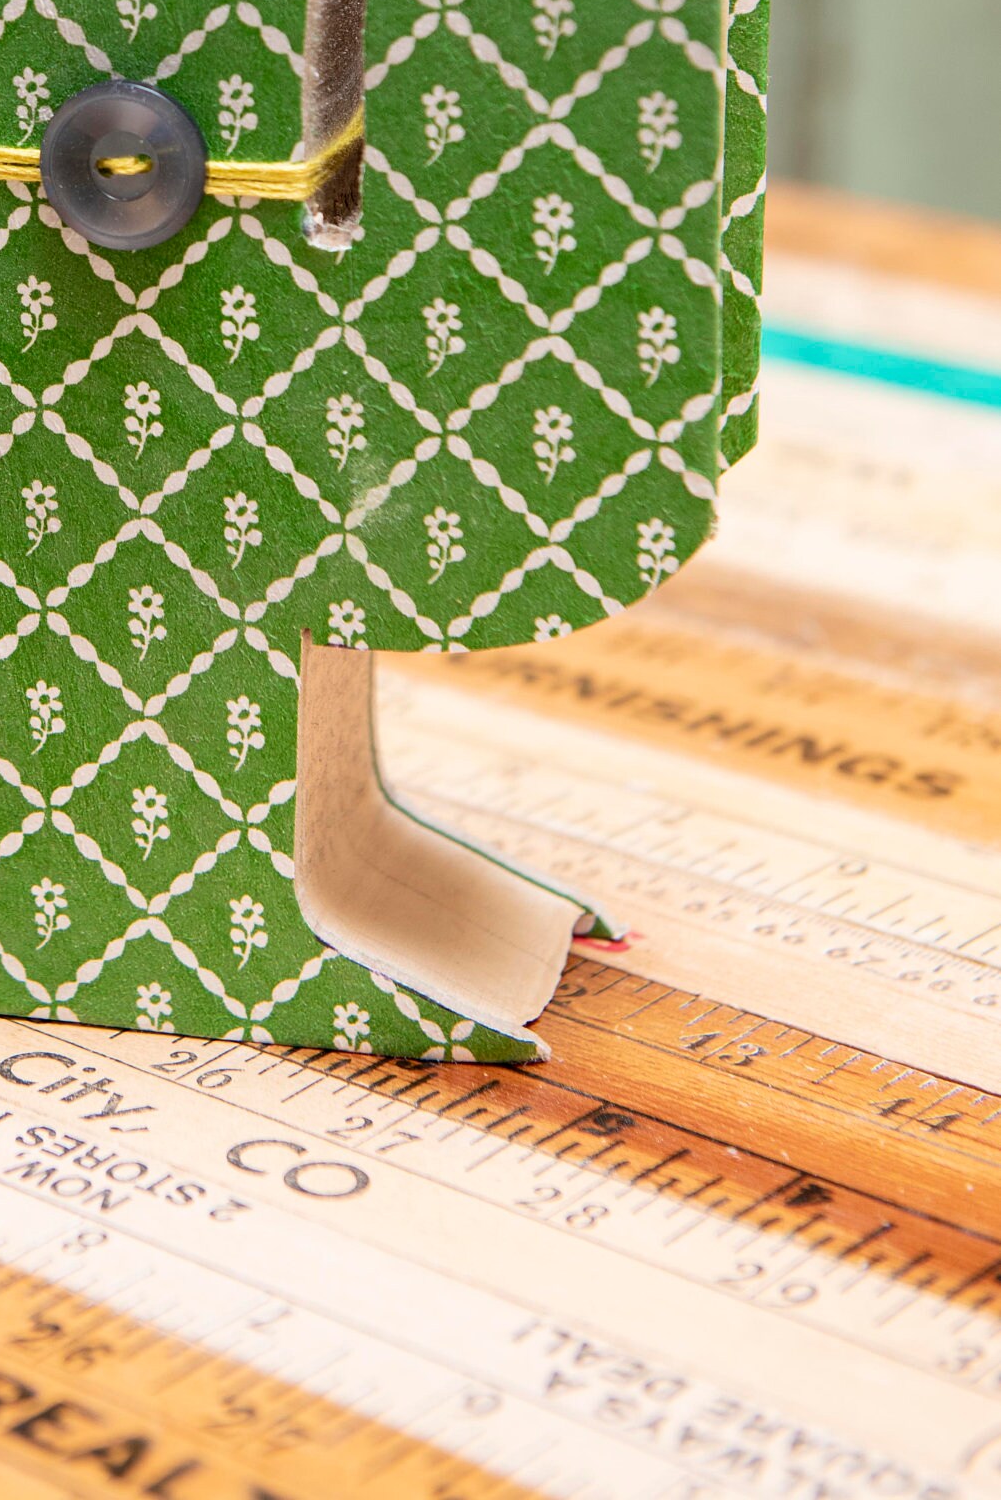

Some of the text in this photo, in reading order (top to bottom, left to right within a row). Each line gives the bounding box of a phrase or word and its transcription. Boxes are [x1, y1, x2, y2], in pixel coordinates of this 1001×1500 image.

[678, 1030, 768, 1067] 43
[150, 1049, 246, 1089] 26
[324, 1115, 423, 1155] 27
[868, 1097, 963, 1133] 44
[3, 1151, 132, 1213] NOW,
[14, 1125, 208, 1207] STORES
[226, 1138, 371, 1198] CO
[208, 1198, 254, 1223] 2
[513, 1185, 610, 1231] 28
